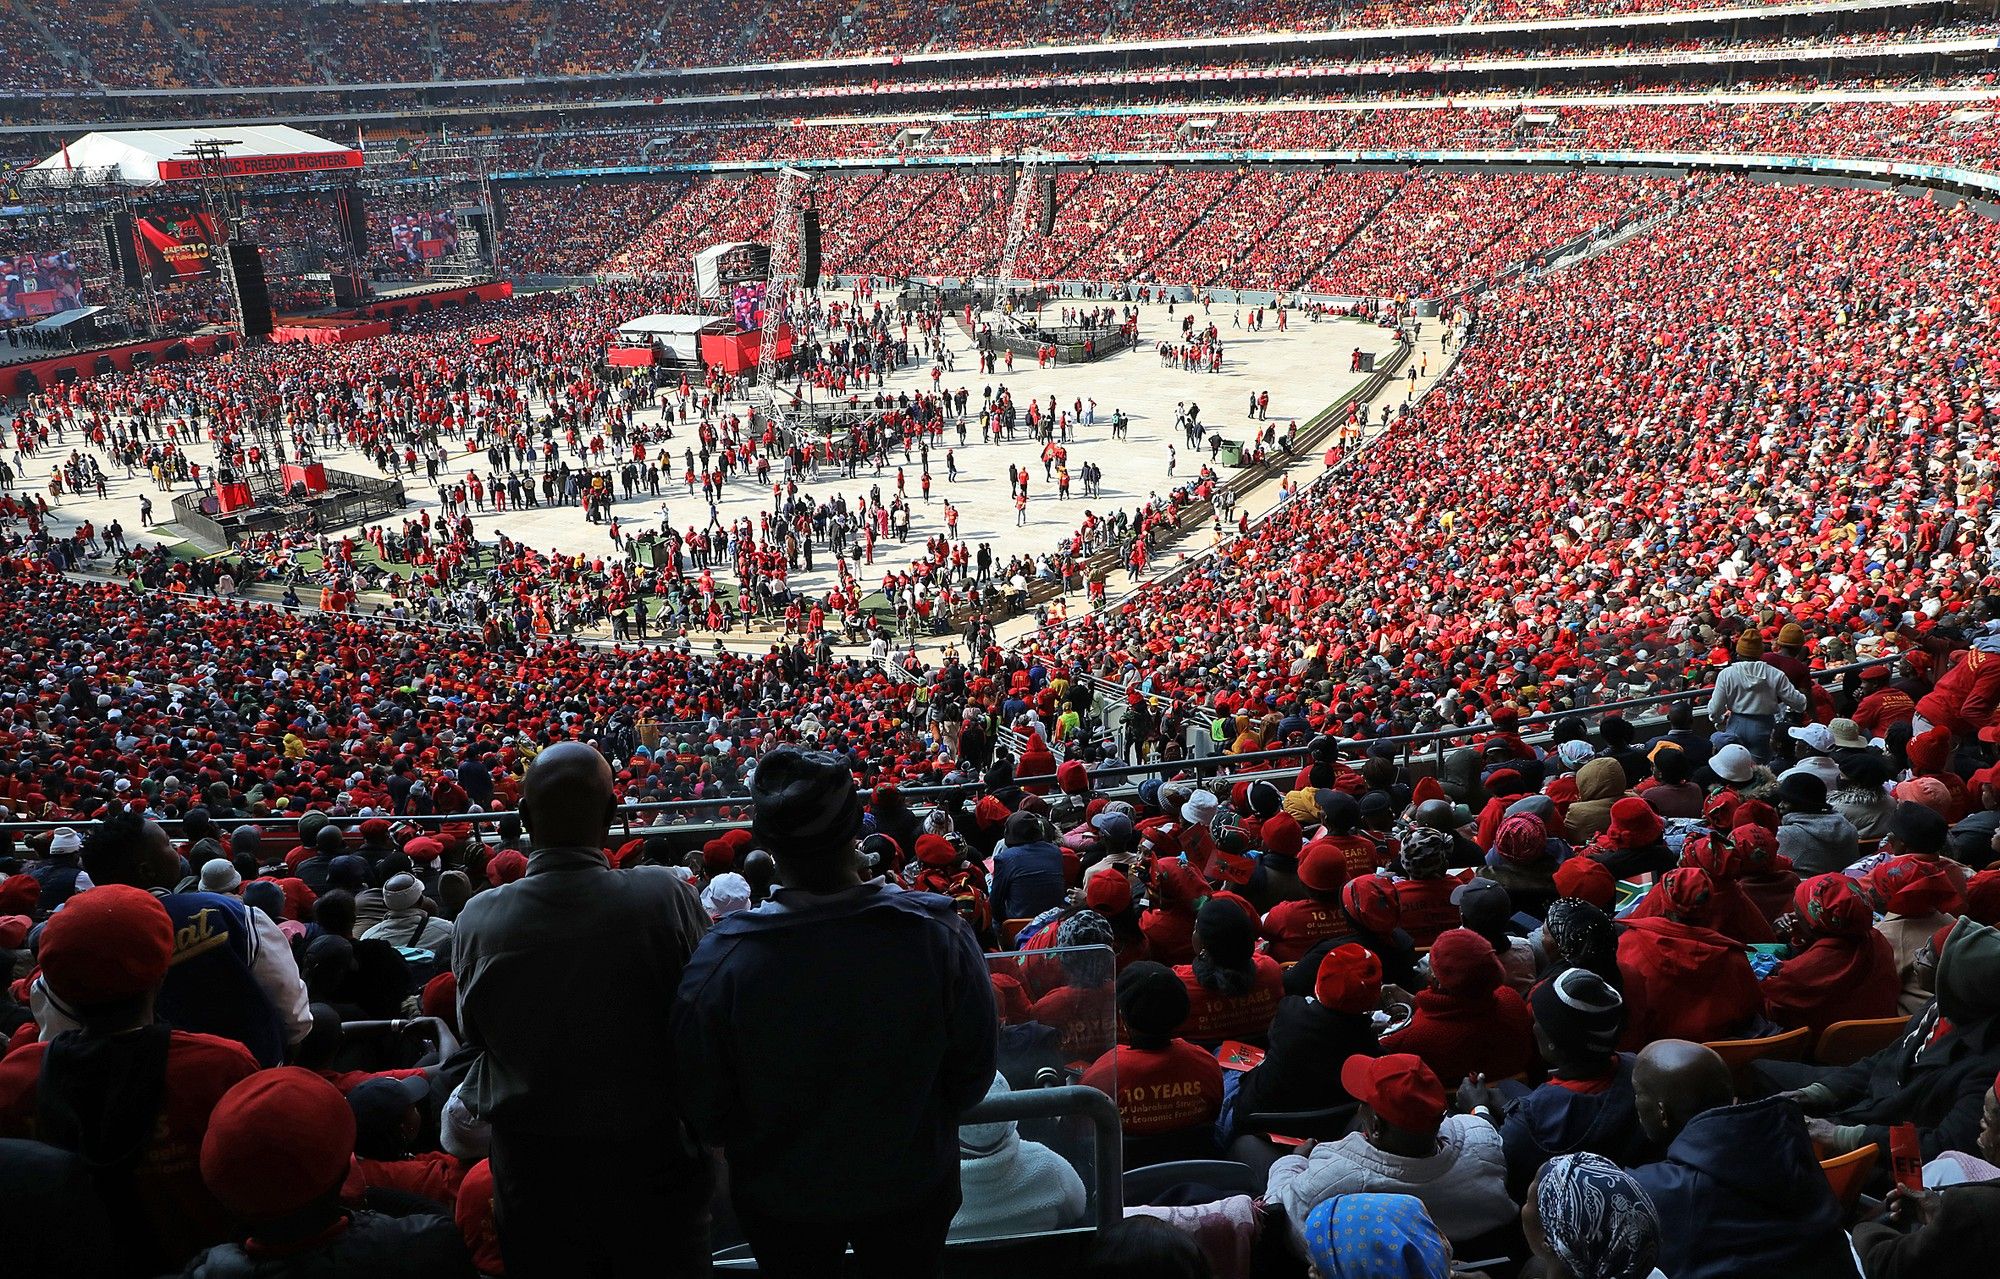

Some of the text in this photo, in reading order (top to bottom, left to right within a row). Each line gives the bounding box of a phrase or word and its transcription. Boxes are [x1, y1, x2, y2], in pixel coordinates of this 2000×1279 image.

[180, 154, 348, 177] ECOMIC FREEDOM FIGHTERS
[1344, 848, 1369, 858] EARS
[1311, 911, 1327, 921] 10
[1206, 988, 1271, 1013] 10 YEARS
[1124, 1080, 1202, 1103] 10 YEARS
[1132, 1113, 1173, 1124] Economic
